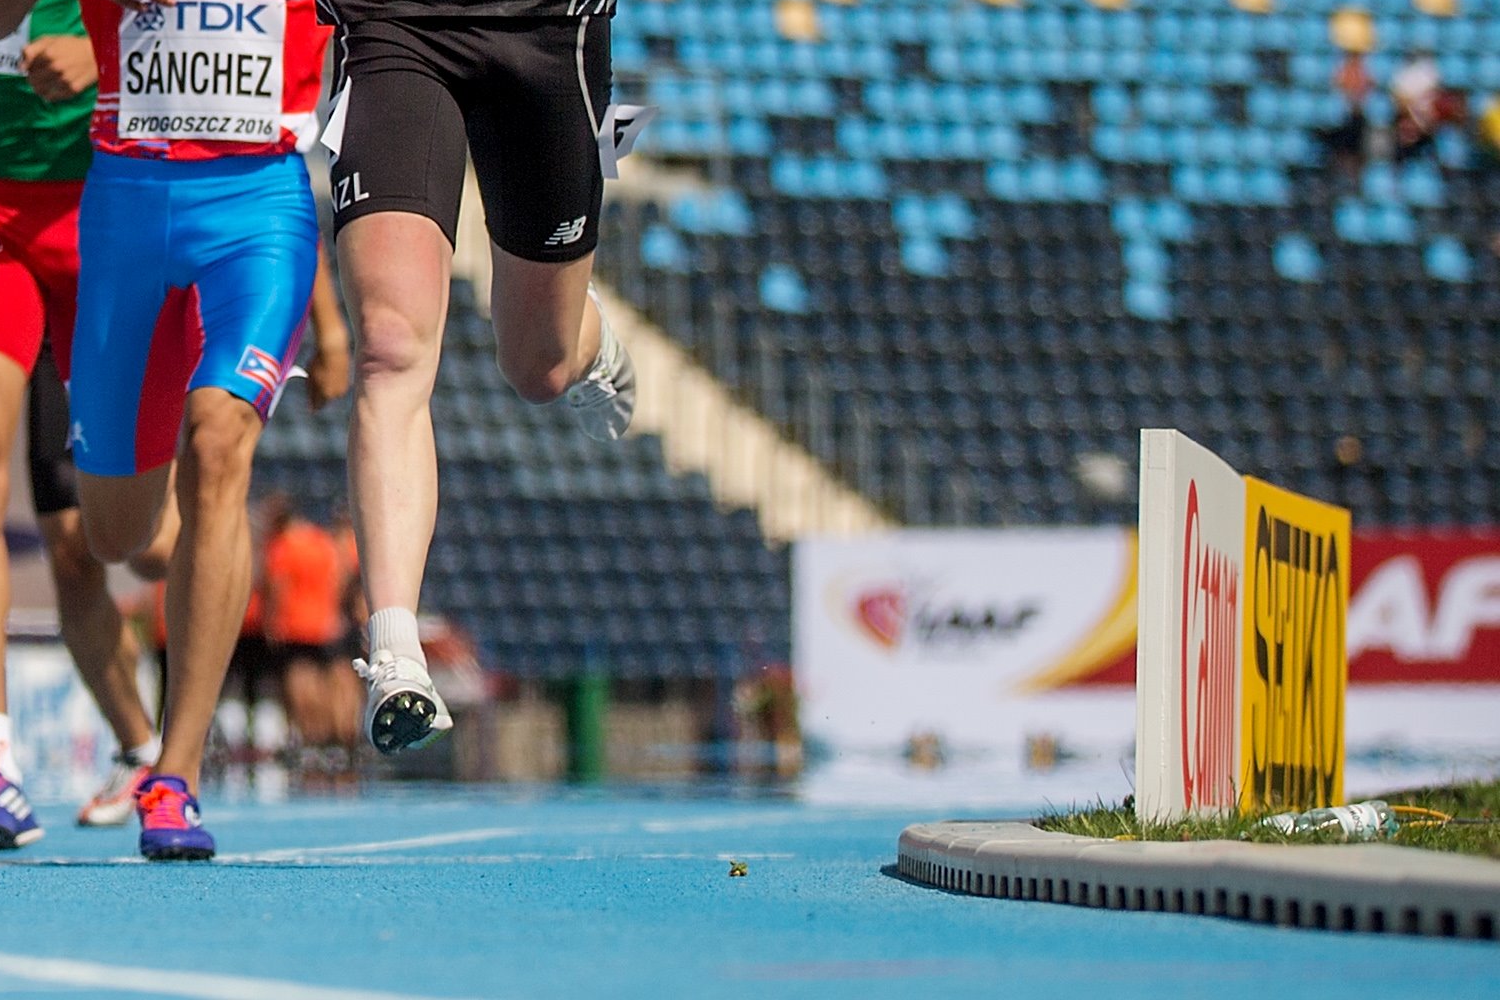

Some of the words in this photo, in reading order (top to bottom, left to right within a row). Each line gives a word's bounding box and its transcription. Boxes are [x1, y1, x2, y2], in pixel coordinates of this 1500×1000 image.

[175, 2, 267, 34] TDK
[126, 41, 273, 97] SÁNCHEZ
[126, 117, 231, 134] BYDGOSZCZ
[234, 119, 273, 135] 2016
[1181, 478, 1238, 810] Canon
[1252, 505, 1340, 811] SEIKO
